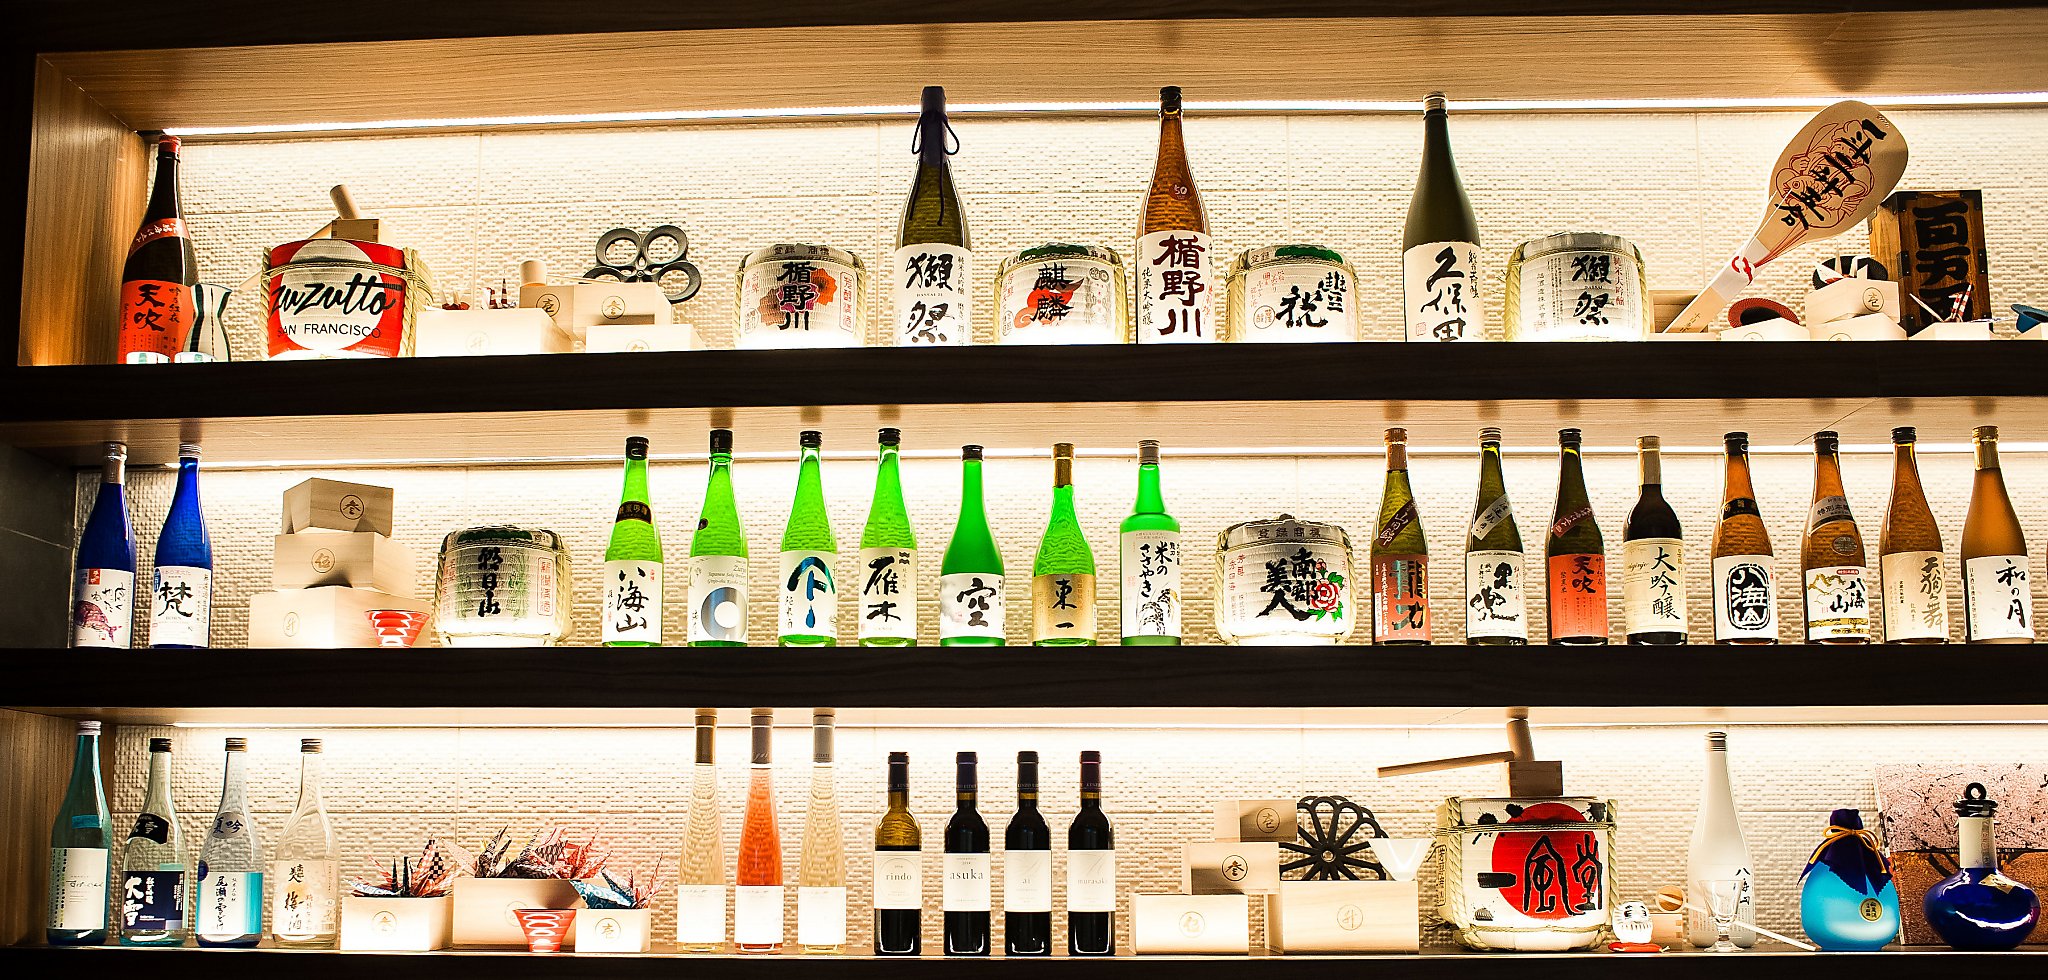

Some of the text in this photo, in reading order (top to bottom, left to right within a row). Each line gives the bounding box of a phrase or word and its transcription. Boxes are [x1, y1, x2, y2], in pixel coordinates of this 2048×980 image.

[1775, 119, 1887, 230] 一斗二升五合
[134, 284, 165, 332] 天吹
[777, 261, 818, 331] 楯野川
[906, 253, 955, 343] 獺祭
[1030, 262, 1075, 322] 麒麟
[1153, 235, 1206, 337] 楯野川
[1421, 246, 1466, 342] 久保田
[1571, 255, 1614, 325] 獺祭
[304, 324, 381, 338] FRANCISCO
[863, 556, 901, 622] 雁木
[1139, 544, 1154, 598] ささやき
[1154, 541, 1172, 575] 米の
[1256, 558, 1310, 621] 美人
[1290, 547, 1319, 605] 南部
[1572, 556, 1596, 593] 天吹
[1650, 547, 1681, 620] 大吟醸
[158, 581, 193, 617] 梵
[616, 567, 649, 633] 八海山
[957, 578, 996, 627] 空
[1053, 578, 1077, 628] 東一
[1920, 557, 1943, 633] 天狗舞
[1996, 558, 2025, 628] 和の月
[886, 872, 912, 880] rindo
[949, 868, 984, 880] asuka
[1477, 834, 1604, 917] 一風堂
